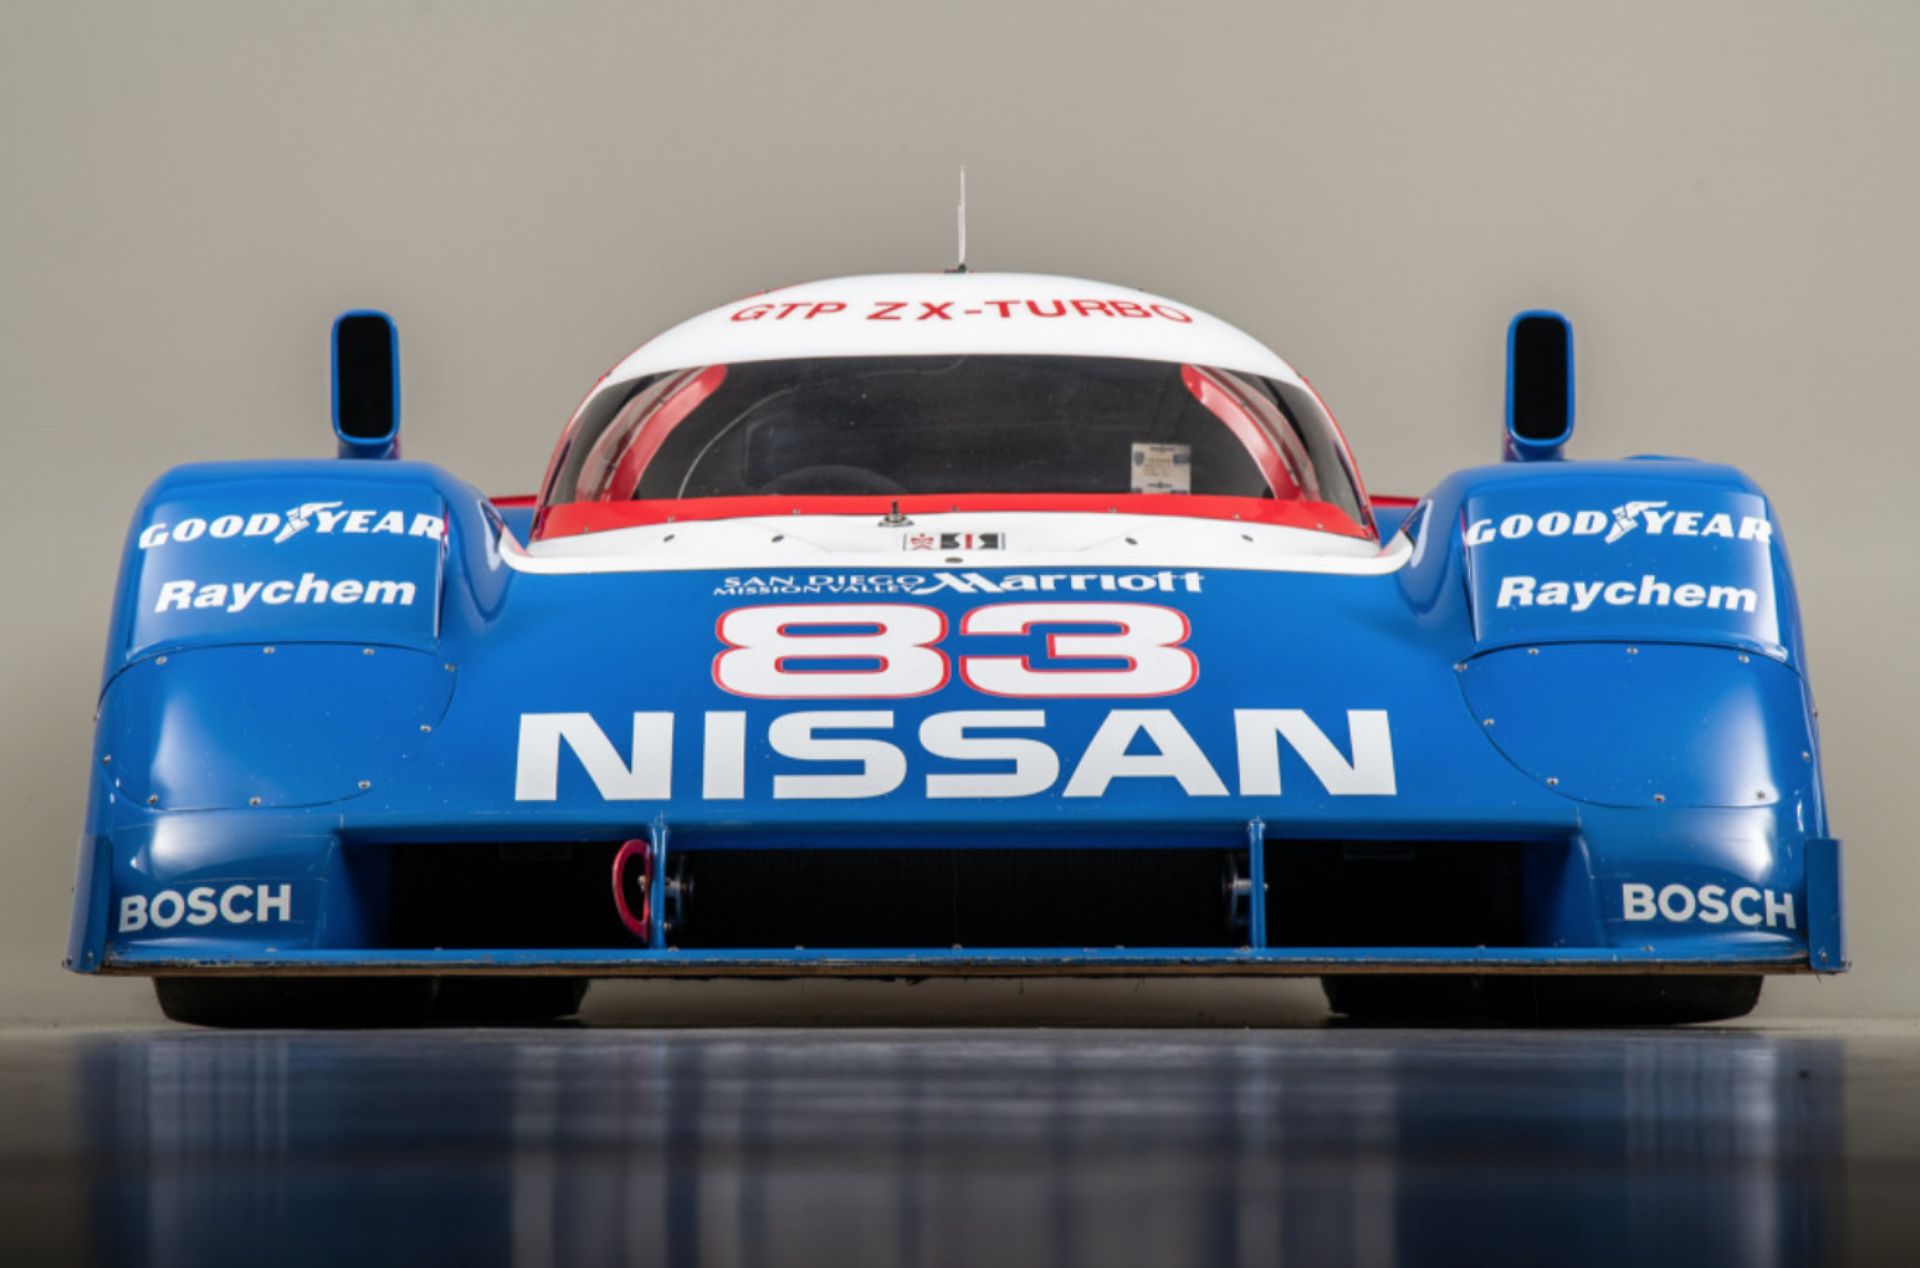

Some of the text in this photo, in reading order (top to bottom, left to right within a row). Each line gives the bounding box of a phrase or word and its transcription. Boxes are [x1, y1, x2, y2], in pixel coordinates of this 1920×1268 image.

[730, 302, 847, 322] GTP
[154, 573, 416, 613] Raychem
[713, 584, 916, 596] MISSION VALLEY
[724, 574, 926, 588] SAN DIEGO
[910, 570, 1206, 596] Marriott
[1496, 575, 1758, 613] Raychem
[711, 602, 1200, 700] 83
[514, 708, 1398, 802] NISSAN
[118, 884, 292, 933] BOSCH
[1622, 882, 1797, 930] BOSCH
